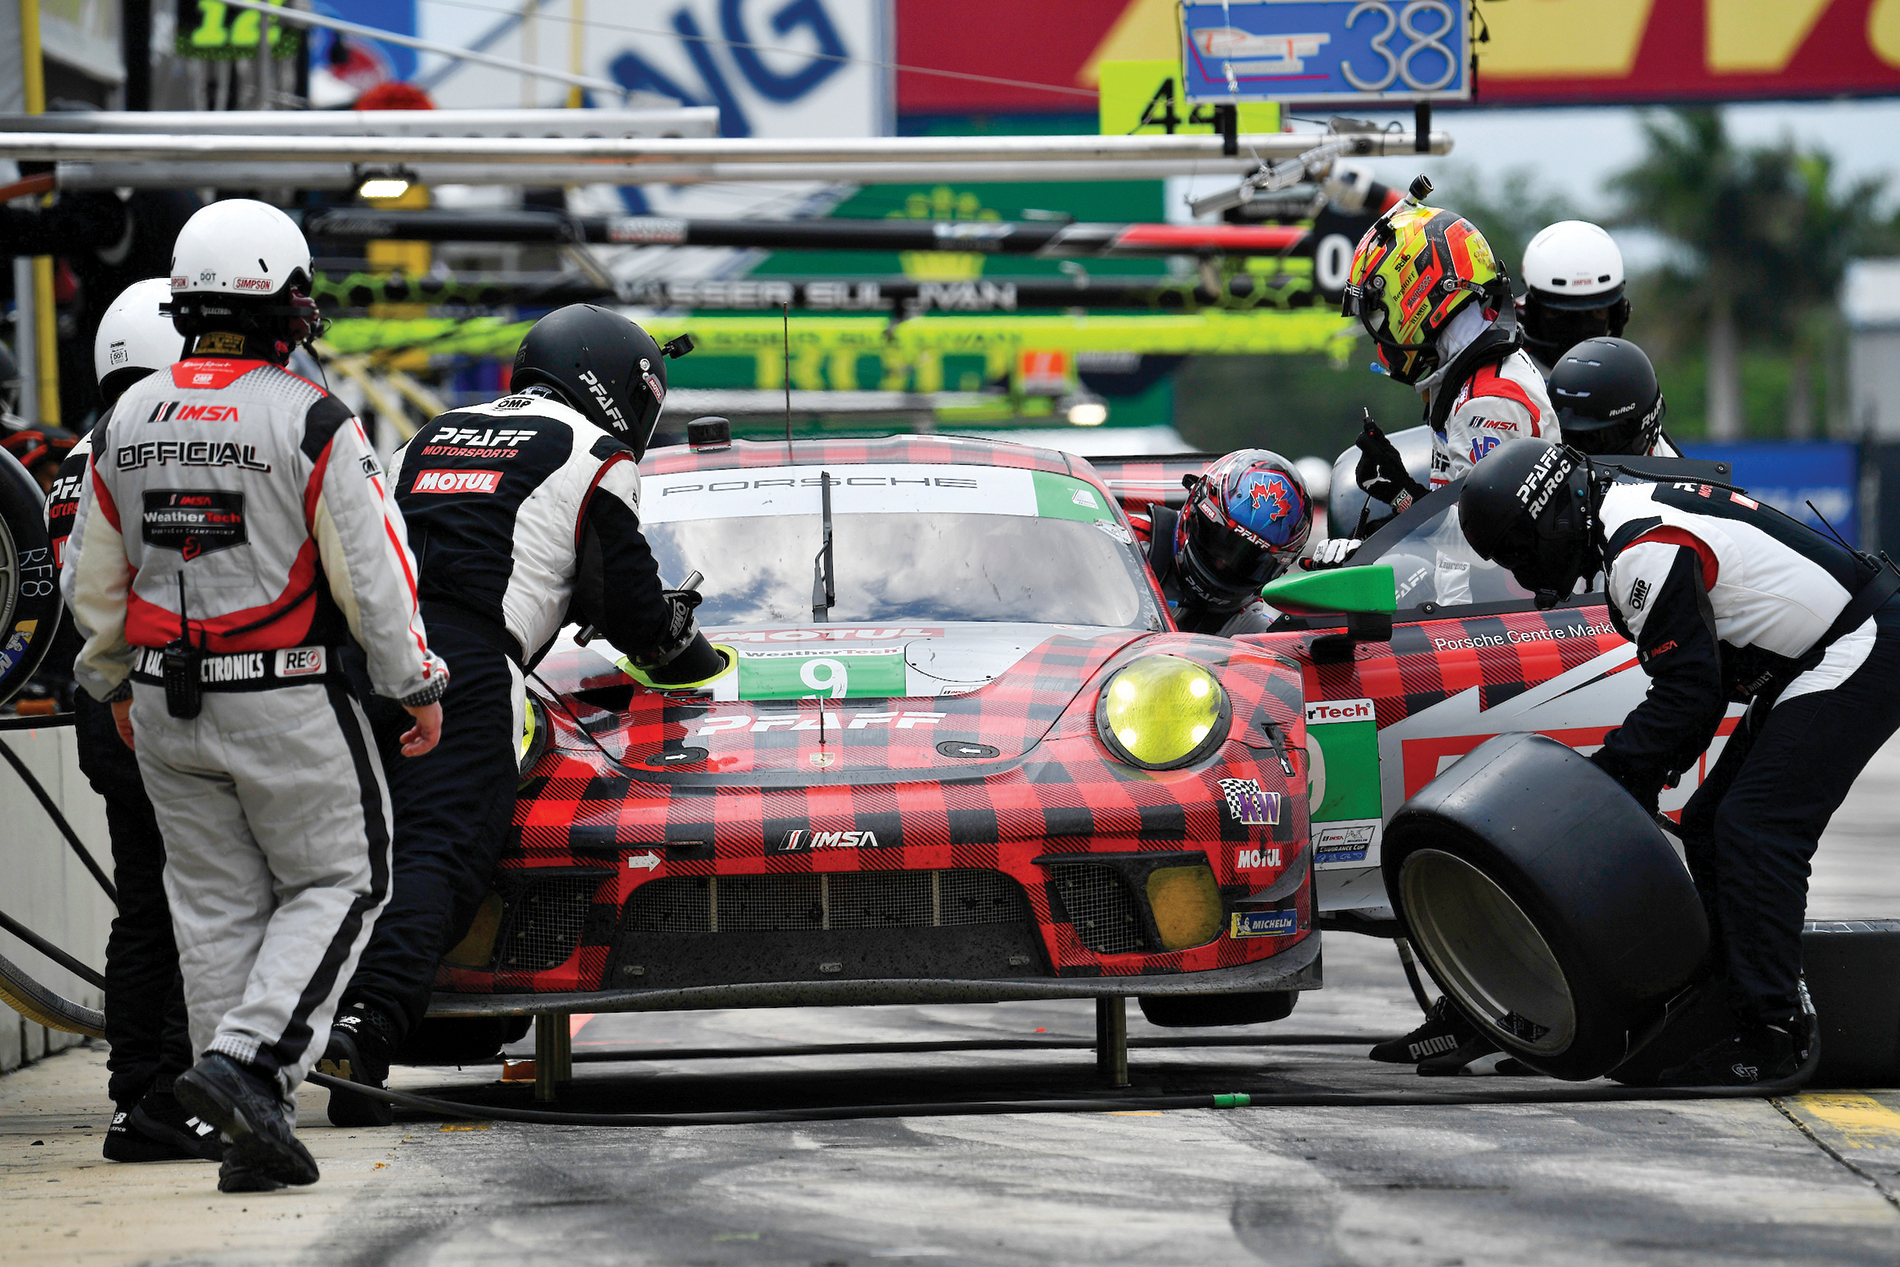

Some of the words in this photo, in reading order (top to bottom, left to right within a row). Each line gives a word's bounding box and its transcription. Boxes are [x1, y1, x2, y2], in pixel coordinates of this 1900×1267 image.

[1340, 1, 1456, 91] 38
[201, 273, 217, 281] DOT
[235, 279, 271, 290] SIMPSON
[649, 378, 663, 400] MOTUL
[497, 399, 532, 410] OMP
[578, 370, 629, 432] PFAFF
[176, 405, 240, 422] IMSA
[1483, 419, 1519, 432] IMSA
[429, 426, 539, 448] PFAFF
[116, 440, 272, 474] OFFICIAL
[420, 445, 519, 459] MOTORSPORTS
[416, 471, 496, 491] MOTUL
[1515, 446, 1560, 505] PFAFF
[662, 477, 978, 498] PORSCHE
[178, 495, 212, 507] IMSA
[1200, 502, 1217, 520] MOTUL
[143, 510, 241, 524] WeatherTech
[1233, 525, 1271, 550] PFAFF
[1631, 579, 1648, 610] OMP
[670, 601, 688, 638] OMP
[708, 628, 932, 641] MOTUL
[1434, 626, 1505, 651] Porsche
[1506, 621, 1566, 645] Centre
[745, 648, 898, 658] WeatherTech
[1651, 640, 1678, 658] IMSA
[800, 658, 848, 699] 9
[697, 711, 947, 736] PFAFF
[1237, 793, 1281, 824] KW
[810, 831, 879, 848] IMSA
[1238, 849, 1282, 868] MOTUL
[1252, 917, 1293, 930] MICHELIN
[1408, 1034, 1459, 1061] PUMA
